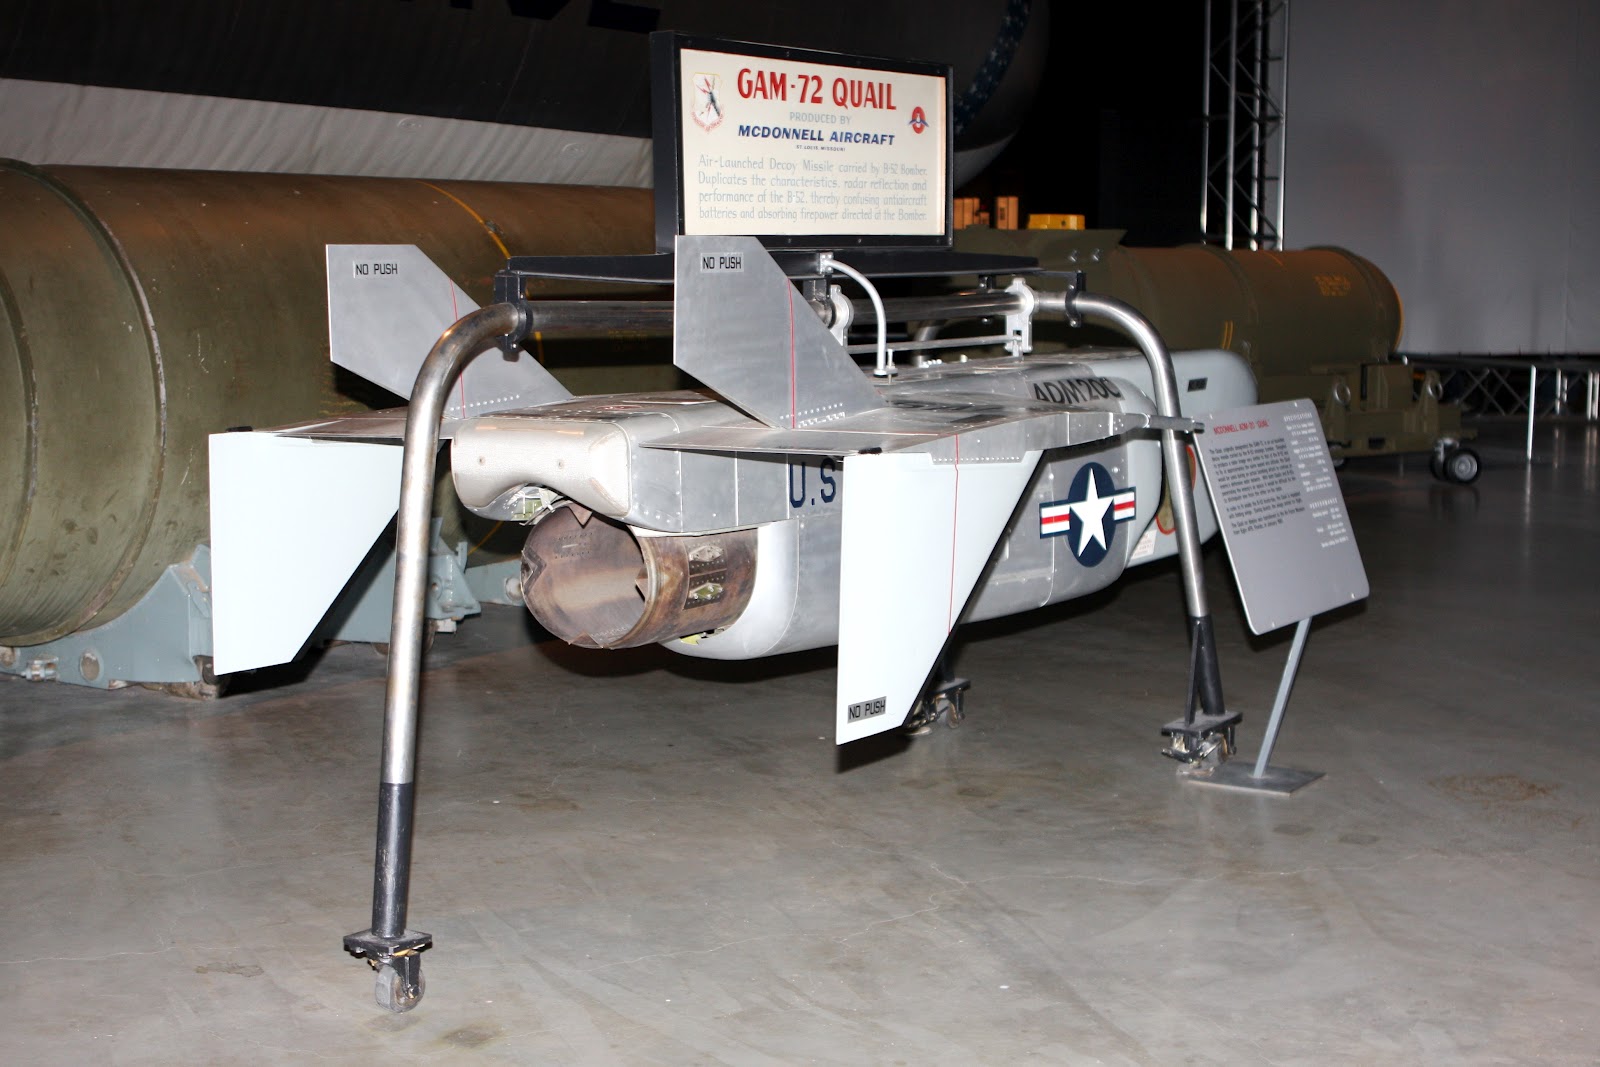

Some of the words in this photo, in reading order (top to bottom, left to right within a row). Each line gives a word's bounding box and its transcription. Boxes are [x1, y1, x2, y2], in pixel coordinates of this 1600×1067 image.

[737, 68, 824, 104] GAM-72
[832, 77, 897, 111] QUAIL
[789, 111, 837, 125] PRODUCED
[840, 115, 852, 125] BY
[738, 125, 825, 142] MCDONNELL
[829, 131, 895, 146] AIRCRAFT
[698, 154, 764, 170] Air-Launched
[769, 157, 797, 175] Decoy
[803, 159, 834, 172] Missile
[838, 162, 867, 173] carried
[870, 162, 880, 177] by
[698, 171, 748, 187] Duplicates
[751, 174, 766, 186] the
[844, 177, 868, 189] radar
[870, 178, 910, 191] reflection
[912, 179, 927, 191] and
[698, 187, 754, 204] performance
[757, 189, 768, 203] of
[770, 190, 784, 204] the
[810, 191, 840, 208] thereby
[843, 192, 880, 209] confusing
[883, 194, 928, 206] antiaircraft
[699, 206, 738, 219] batteries
[740, 206, 755, 219] and
[757, 206, 797, 222] absorbing
[800, 207, 839, 223] firepower
[841, 208, 873, 221] directed
[874, 209, 882, 221] at
[884, 208, 896, 221] the
[355, 263, 369, 276] NO
[373, 263, 398, 275] PUSH
[702, 256, 715, 270] NO
[719, 256, 742, 270] PUSH
[849, 705, 861, 720] NO
[864, 699, 886, 717] PUSH
